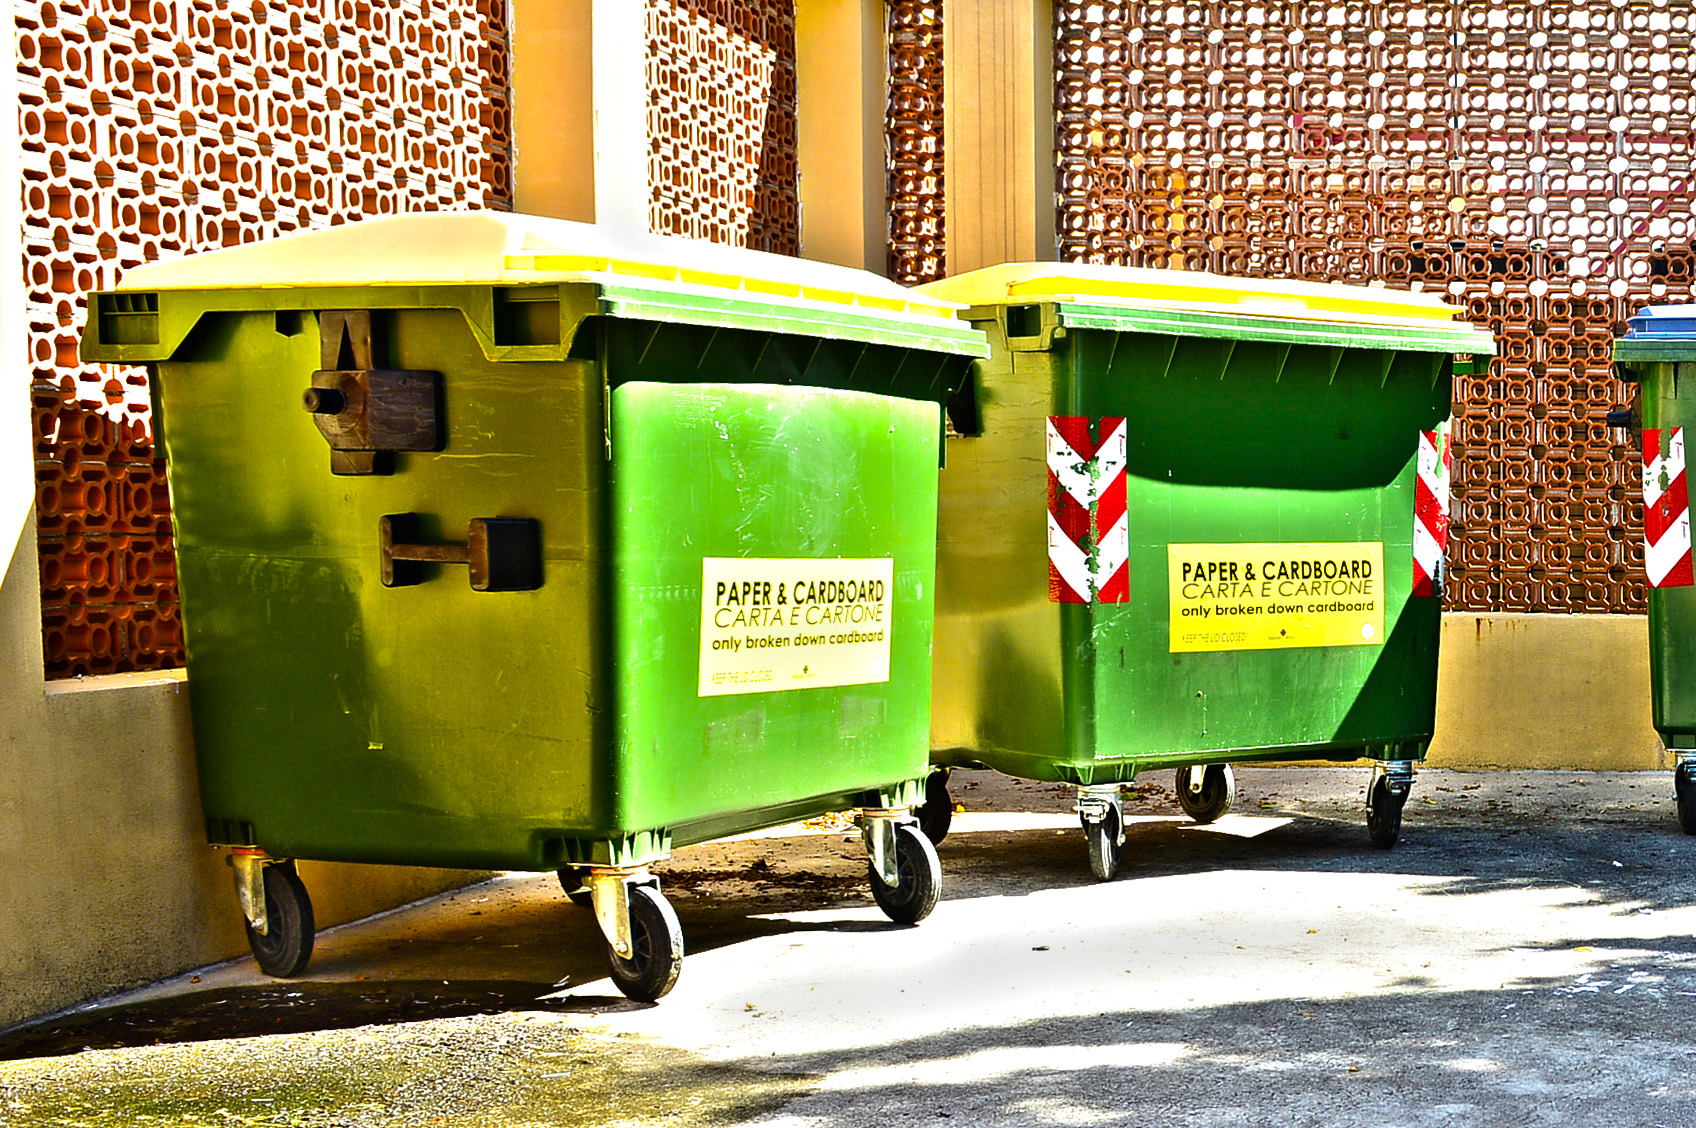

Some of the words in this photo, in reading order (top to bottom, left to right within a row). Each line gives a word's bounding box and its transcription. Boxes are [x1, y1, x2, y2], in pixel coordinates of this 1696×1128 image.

[1182, 562, 1239, 582] PAPER
[1245, 562, 1256, 580] &
[1262, 560, 1372, 580] CARDBOARD
[716, 581, 772, 606] PAPER
[777, 582, 788, 605] &
[793, 580, 885, 605] CARDBOARD
[1182, 582, 1254, 599] CARTA
[1261, 581, 1272, 597] E
[1278, 579, 1373, 597] CARTONE
[714, 607, 784, 628] CARTA
[790, 606, 800, 626] E
[805, 604, 884, 625] CARTONE
[1181, 604, 1211, 618] only
[1215, 603, 1263, 616] broken
[1267, 603, 1304, 614] down
[1307, 600, 1374, 613] cardboard
[712, 636, 742, 652] only
[746, 635, 790, 649] broken
[794, 633, 825, 647] down
[829, 629, 884, 644] cardboard
